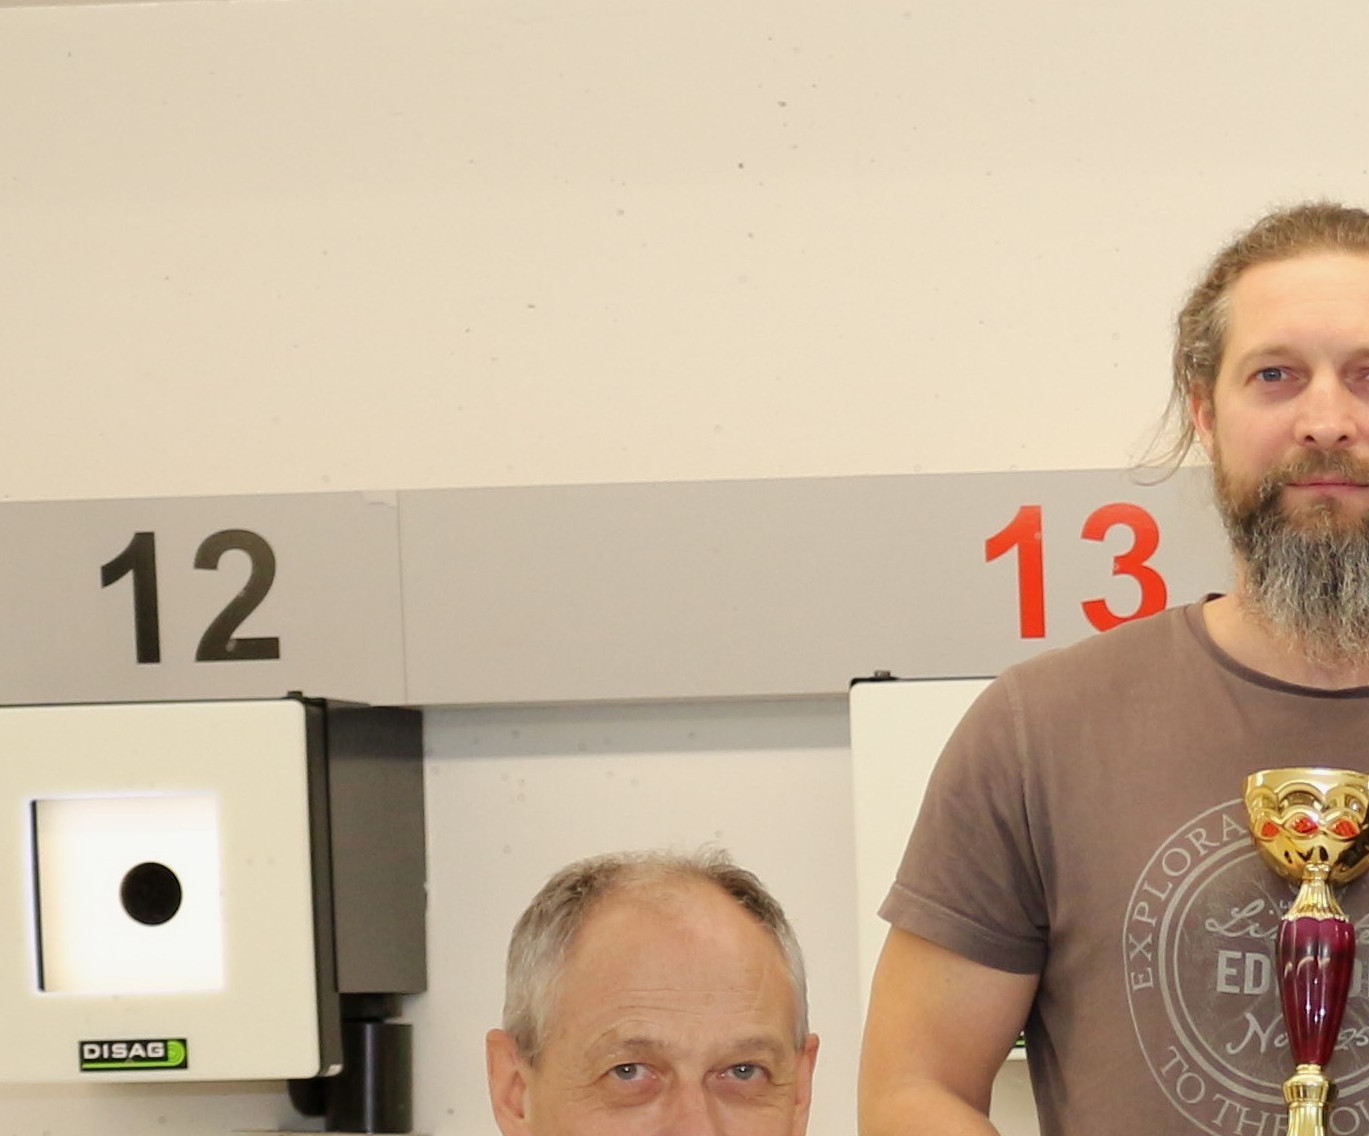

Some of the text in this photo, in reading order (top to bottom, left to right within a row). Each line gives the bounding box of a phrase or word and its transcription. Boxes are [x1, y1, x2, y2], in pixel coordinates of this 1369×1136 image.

[100, 528, 280, 664] 12
[984, 502, 1167, 640] 13
[82, 1041, 165, 1060] DISAG
[1159, 1046, 1206, 1105] TO
